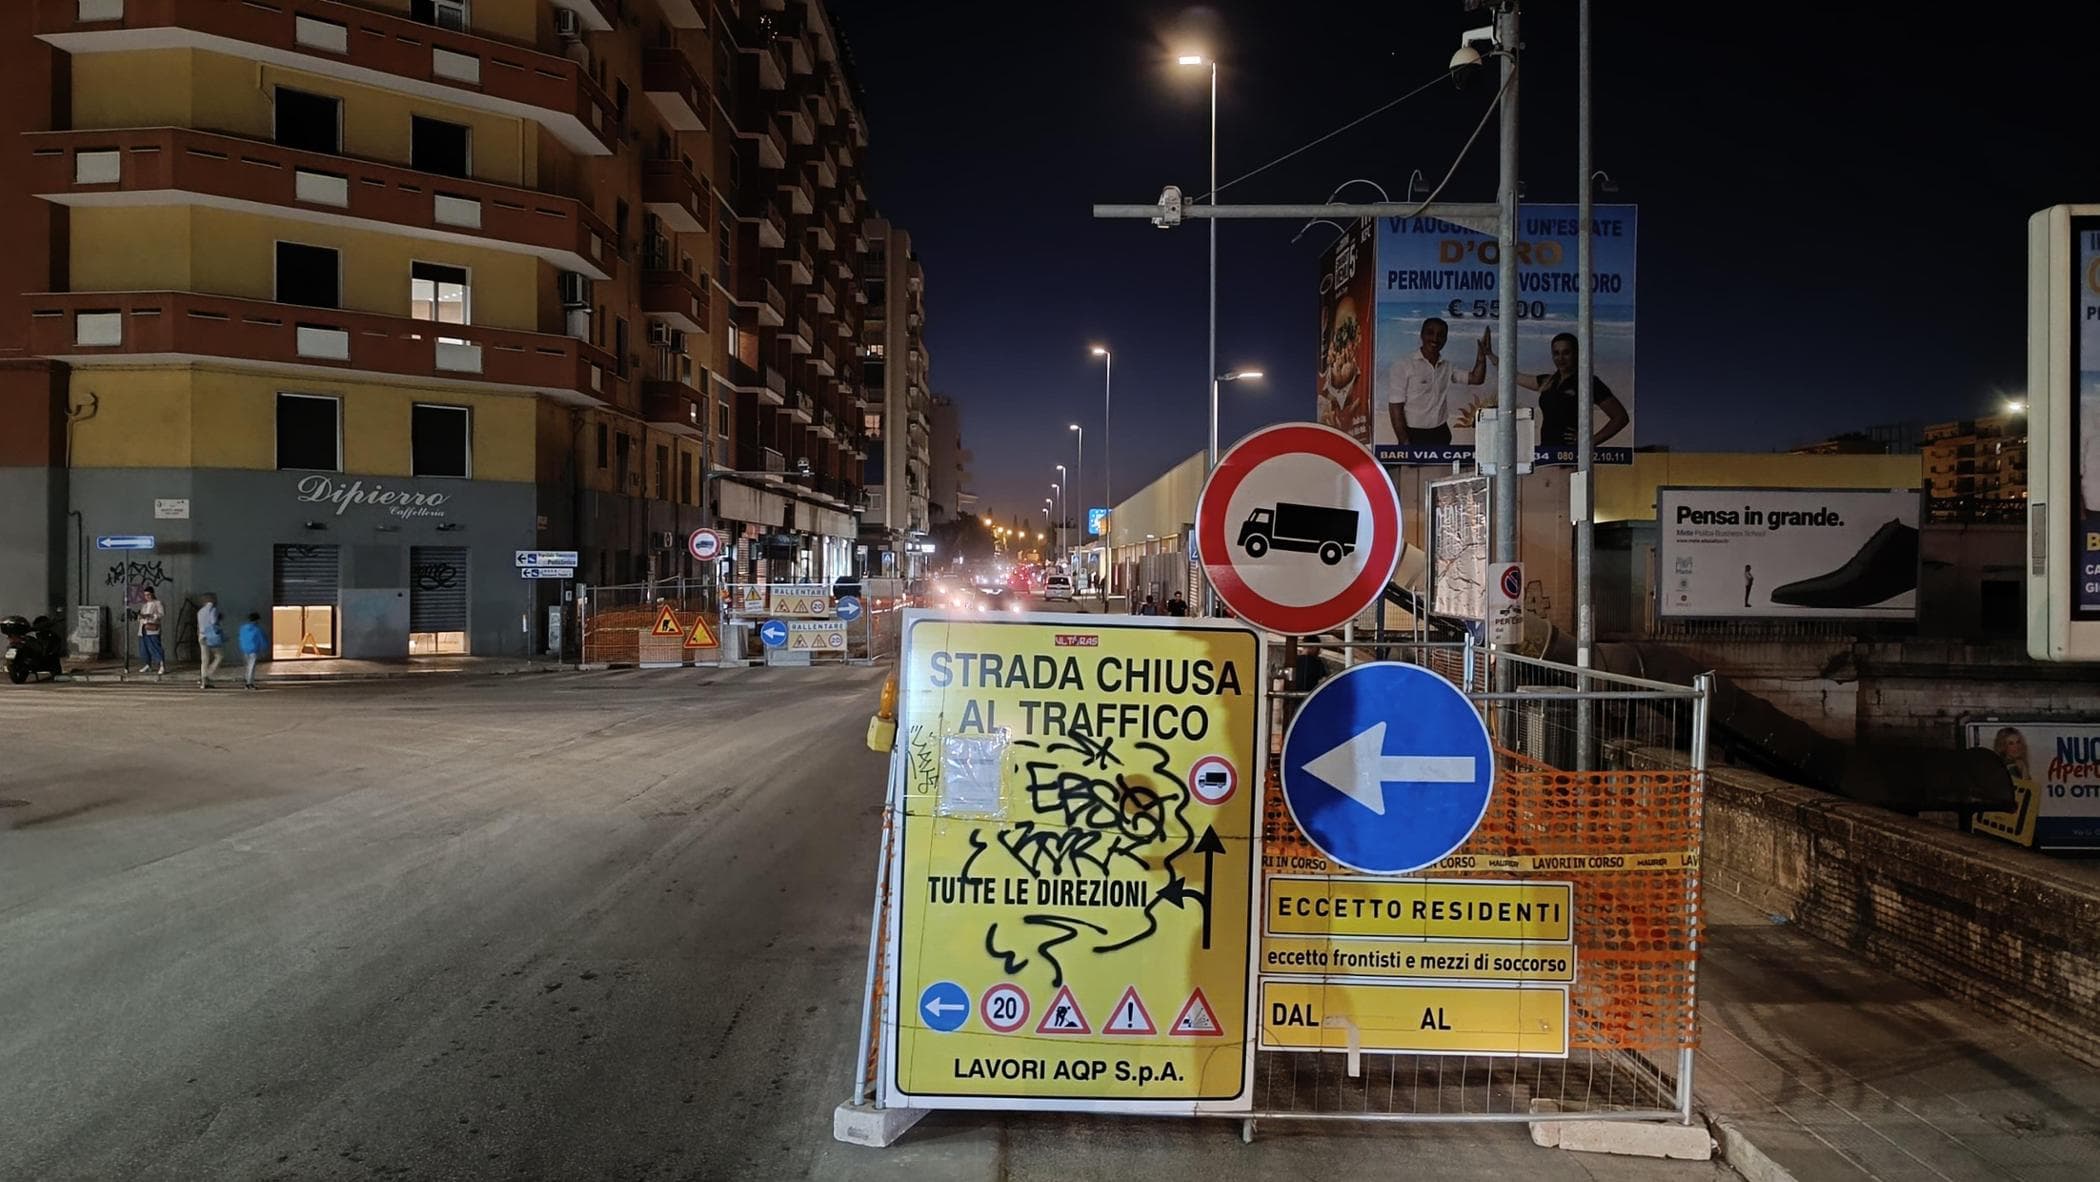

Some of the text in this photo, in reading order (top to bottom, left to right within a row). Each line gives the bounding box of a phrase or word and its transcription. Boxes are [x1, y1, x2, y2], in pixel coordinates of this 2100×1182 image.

[1390, 217, 1406, 233] VI
[1527, 219, 1622, 236] UN'ESATE
[1440, 240, 1564, 266] D'ORO
[1388, 270, 1495, 290] PERMUTIAMO
[1448, 299, 1463, 317] €
[1380, 451, 1408, 460] BARI
[1413, 451, 1439, 460] VIA
[297, 475, 450, 515] Dipierro
[1677, 505, 1844, 530] Pensa in grande.
[774, 588, 827, 596] RALLENTARE
[930, 652, 1242, 696] STRADA CHIUSA
[959, 699, 1209, 741] AL TRAFFICO
[2047, 785, 2065, 798] 10
[1276, 856, 1288, 868] IN
[1291, 857, 1327, 870] CORSO
[1440, 856, 1476, 869] CORSO
[1532, 855, 1624, 870] LAVORI IN CORSO
[928, 876, 1147, 908] TUTTE LE DIREZIONI
[1278, 896, 1561, 923] ECCETTO RESIDENTI
[1267, 949, 1567, 973] eccetto frontisti e mezzi di soccorso
[993, 997, 1017, 1019] 20
[1271, 1003, 1451, 1032] DAL AL
[953, 1058, 1184, 1086] LAVORI AQP S.p.A.
